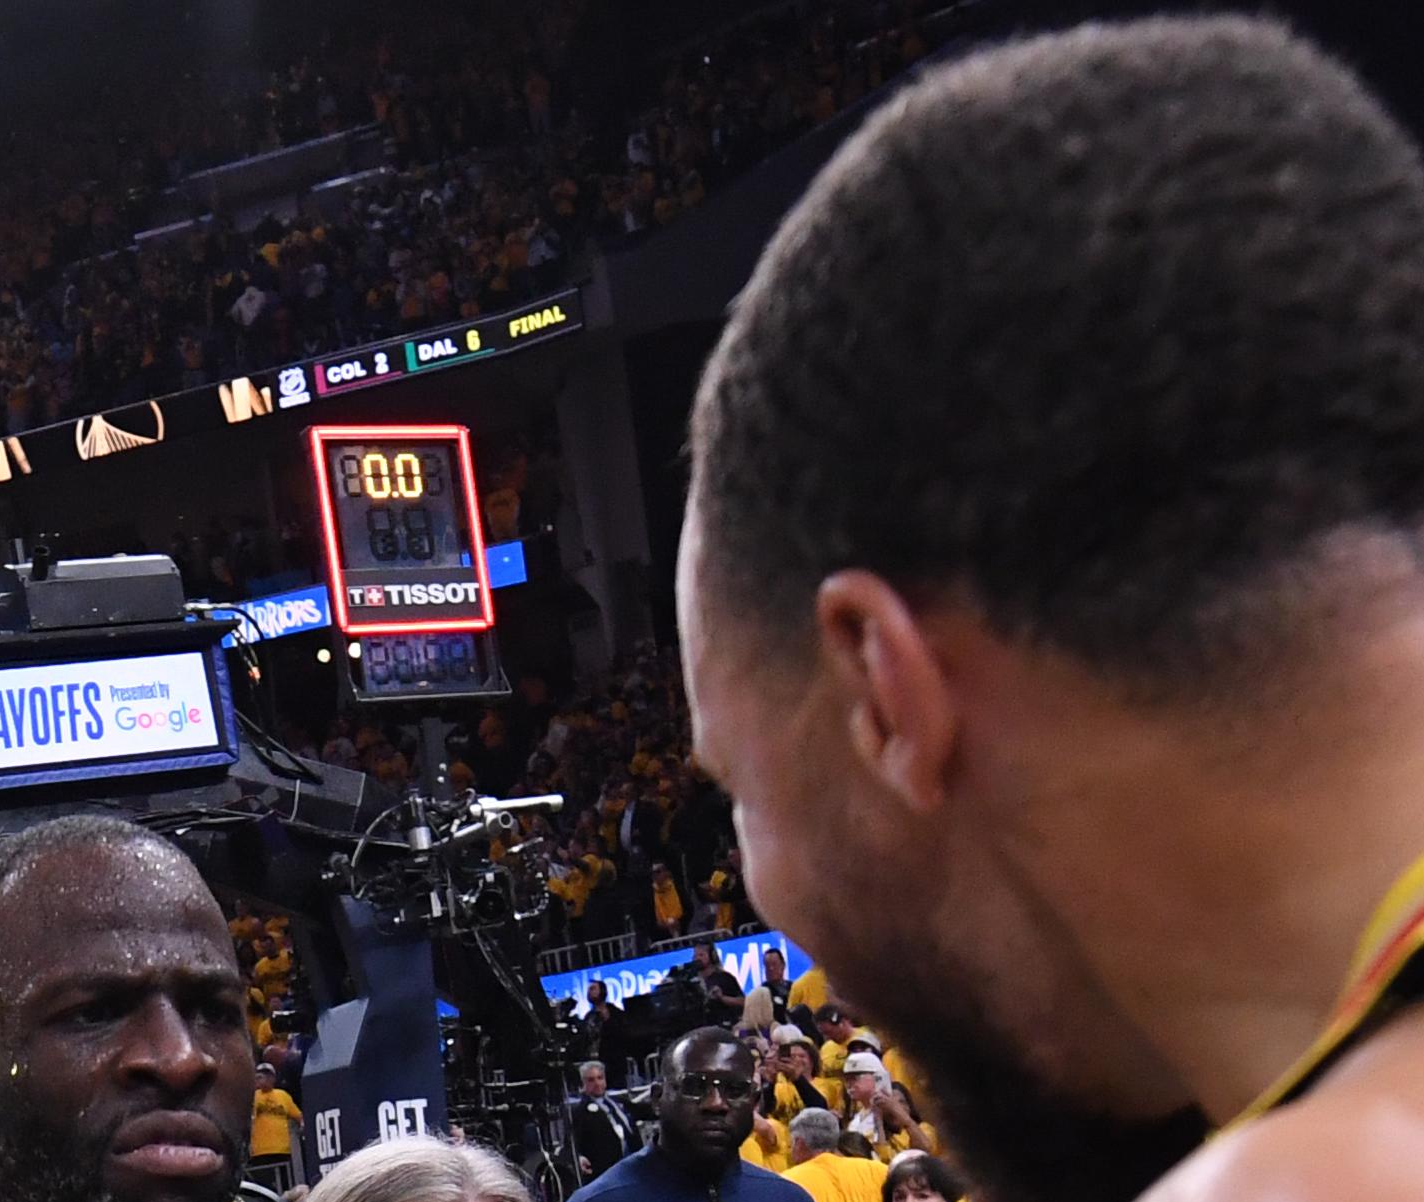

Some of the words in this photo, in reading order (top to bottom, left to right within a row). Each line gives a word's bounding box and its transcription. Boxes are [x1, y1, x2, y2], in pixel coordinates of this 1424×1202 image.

[326, 361, 367, 383] COL
[374, 352, 390, 375] 2
[417, 338, 459, 361] DAL
[466, 330, 481, 351] 6
[509, 305, 566, 338] FINAL
[363, 453, 423, 498] 0.0
[385, 582, 480, 606] TISSOT
[115, 701, 202, 732] Google
[315, 1108, 342, 1160] GET
[378, 1098, 428, 1143] GET
